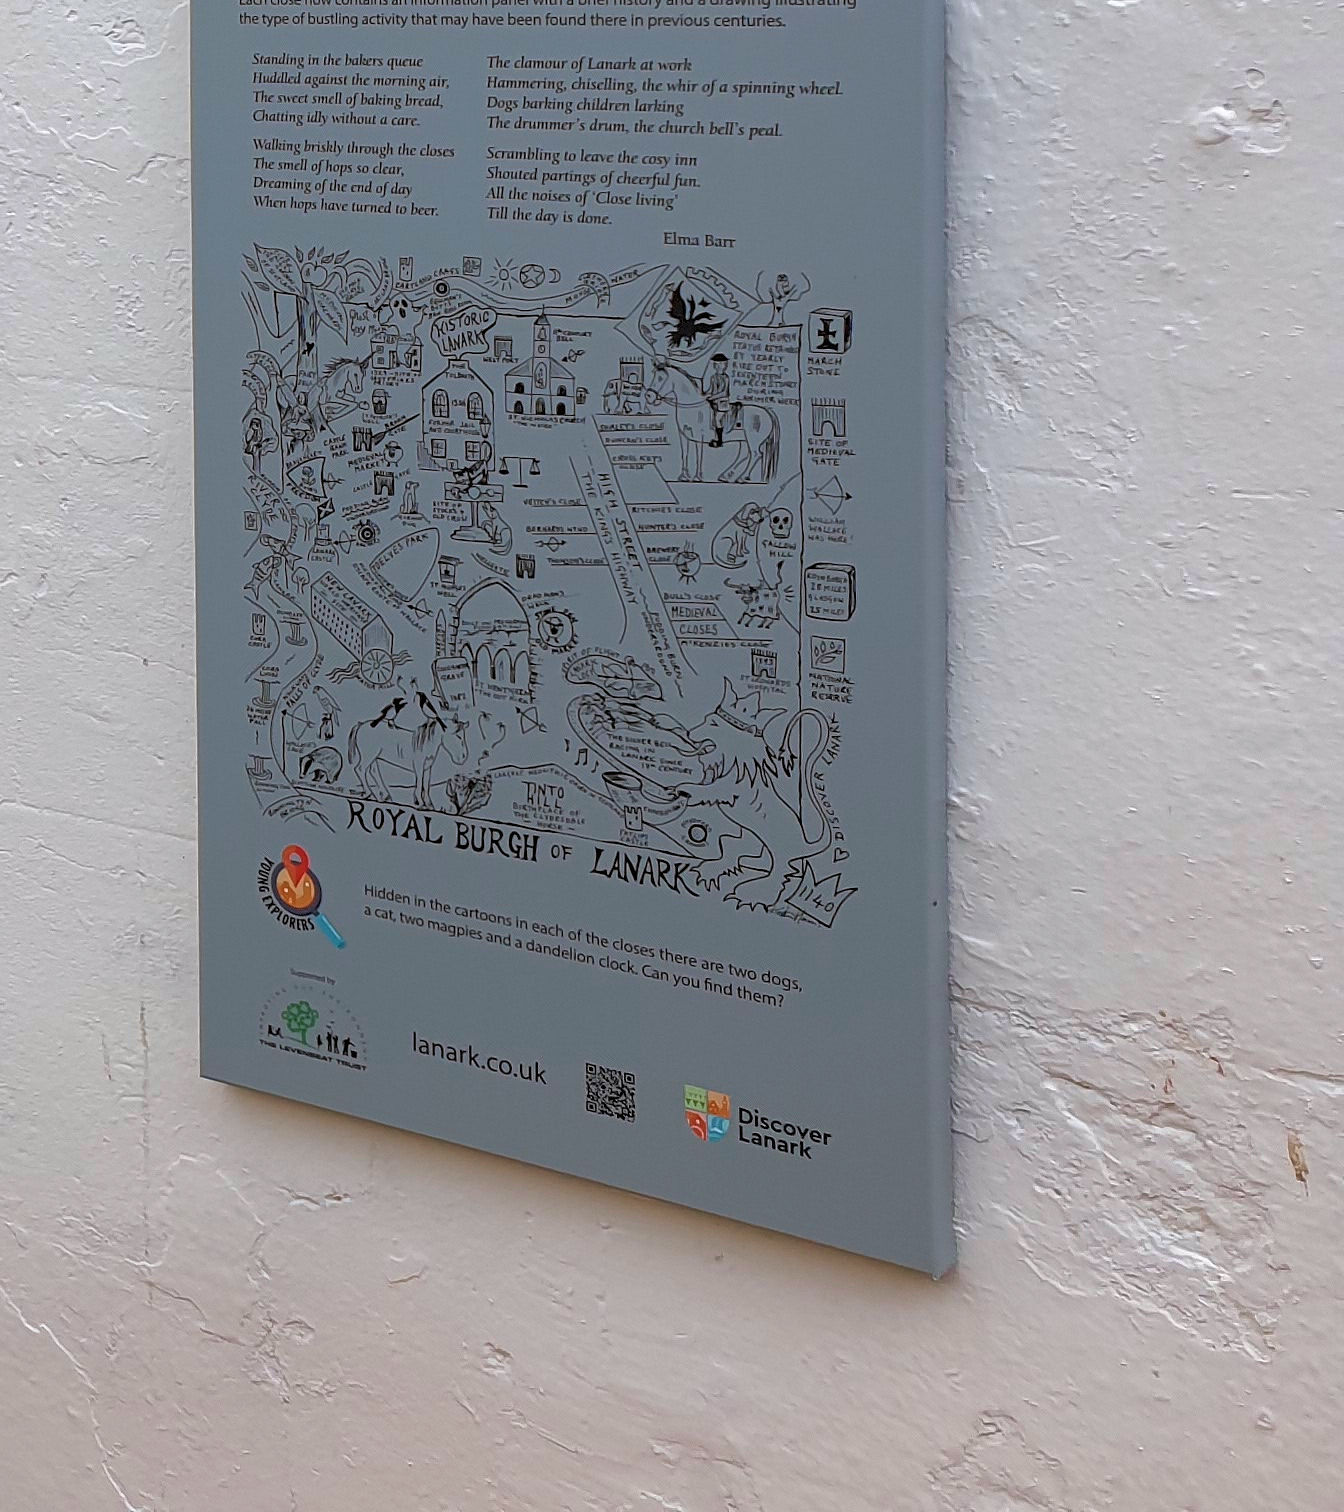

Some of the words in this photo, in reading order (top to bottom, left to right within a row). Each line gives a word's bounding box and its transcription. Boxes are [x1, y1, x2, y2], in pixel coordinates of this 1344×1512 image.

[239, 11, 259, 24] the
[261, 13, 289, 28] type
[291, 11, 305, 25] of
[307, 11, 358, 28] bustling
[361, 13, 408, 28] activity
[410, 11, 438, 26] that
[440, 15, 469, 29] may
[471, 11, 504, 25] have
[507, 11, 542, 26] been
[544, 11, 586, 26] found
[589, 11, 627, 27] there
[630, 13, 644, 27] in
[647, 15, 710, 30] previous
[713, 14, 786, 27] centuries.
[251, 51, 305, 69] Standing
[307, 53, 319, 65] in
[323, 52, 342, 66] the
[344, 52, 383, 67] bakers
[386, 57, 423, 71] queue
[486, 54, 511, 68] The
[513, 54, 568, 69] clamour
[570, 55, 584, 74] of
[587, 56, 636, 70] Lanark
[639, 60, 653, 71] at
[657, 57, 692, 71] work
[486, 95, 518, 113] Dogs
[521, 95, 573, 114] barking
[575, 96, 630, 111] children
[634, 97, 684, 117] larking
[252, 137, 301, 156] Walking
[303, 138, 344, 157] briskly
[346, 140, 393, 159] through
[397, 142, 417, 156] the
[419, 142, 455, 157] closes
[663, 230, 699, 246] Elma
[704, 233, 736, 248] Barr
[436, 309, 490, 338] HISTORIC
[442, 330, 483, 353] LANARK
[597, 472, 617, 511] HIGH
[615, 517, 642, 572] STREET
[580, 471, 597, 499] THE
[611, 551, 638, 605] HIGHWAY
[769, 550, 794, 558] HILL
[671, 605, 717, 618] MEDIEVAL
[679, 623, 718, 636] CLOSES
[347, 799, 443, 845] ROYAL
[454, 821, 540, 862] BURGH
[550, 845, 573, 860] OF
[590, 847, 700, 897] LANARK
[257, 857, 275, 893] YOUNG
[262, 895, 315, 931] EXPLORERS
[364, 883, 410, 905] Hidden
[413, 894, 426, 908] in
[429, 897, 451, 914] the
[454, 905, 512, 927] cartoons
[515, 915, 528, 930] in
[531, 921, 564, 938] each
[567, 928, 581, 942] of
[585, 930, 609, 948] the
[611, 937, 655, 958] closes
[658, 947, 697, 967] there
[700, 959, 724, 973] are
[727, 962, 757, 980] two
[760, 969, 802, 992] dogs,
[363, 905, 371, 916] a
[374, 907, 396, 922] cat,
[399, 911, 424, 927] two
[427, 919, 483, 940] magpies
[485, 931, 511, 947] and
[514, 938, 522, 949] a
[525, 938, 595, 965] dandelion
[598, 954, 638, 975] clock.
[641, 963, 669, 982] Can
[672, 973, 700, 989] you
[703, 976, 733, 996] find
[736, 984, 784, 1008] them?
[412, 1030, 546, 1085] lanark.co.uk
[738, 1106, 832, 1146] Discover
[738, 1125, 812, 1160] Lanark
